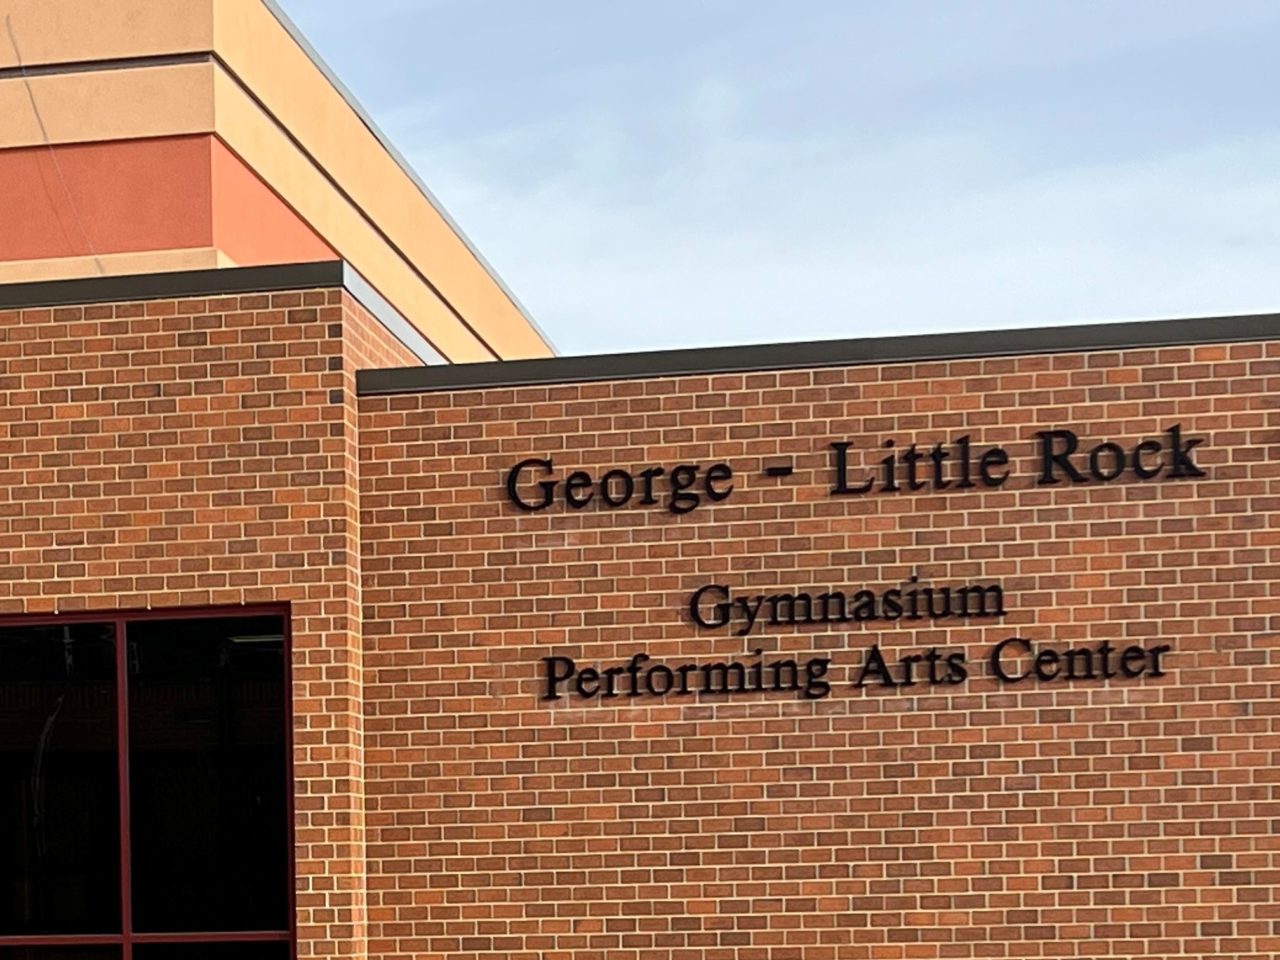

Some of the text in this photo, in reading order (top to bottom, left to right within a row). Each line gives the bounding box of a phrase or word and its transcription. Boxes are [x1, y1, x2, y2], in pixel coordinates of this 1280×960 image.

[508, 424, 1206, 514] George - Little Rock
[689, 576, 1006, 635] Gymnasium
[541, 637, 1171, 700] Performing Arts Center
